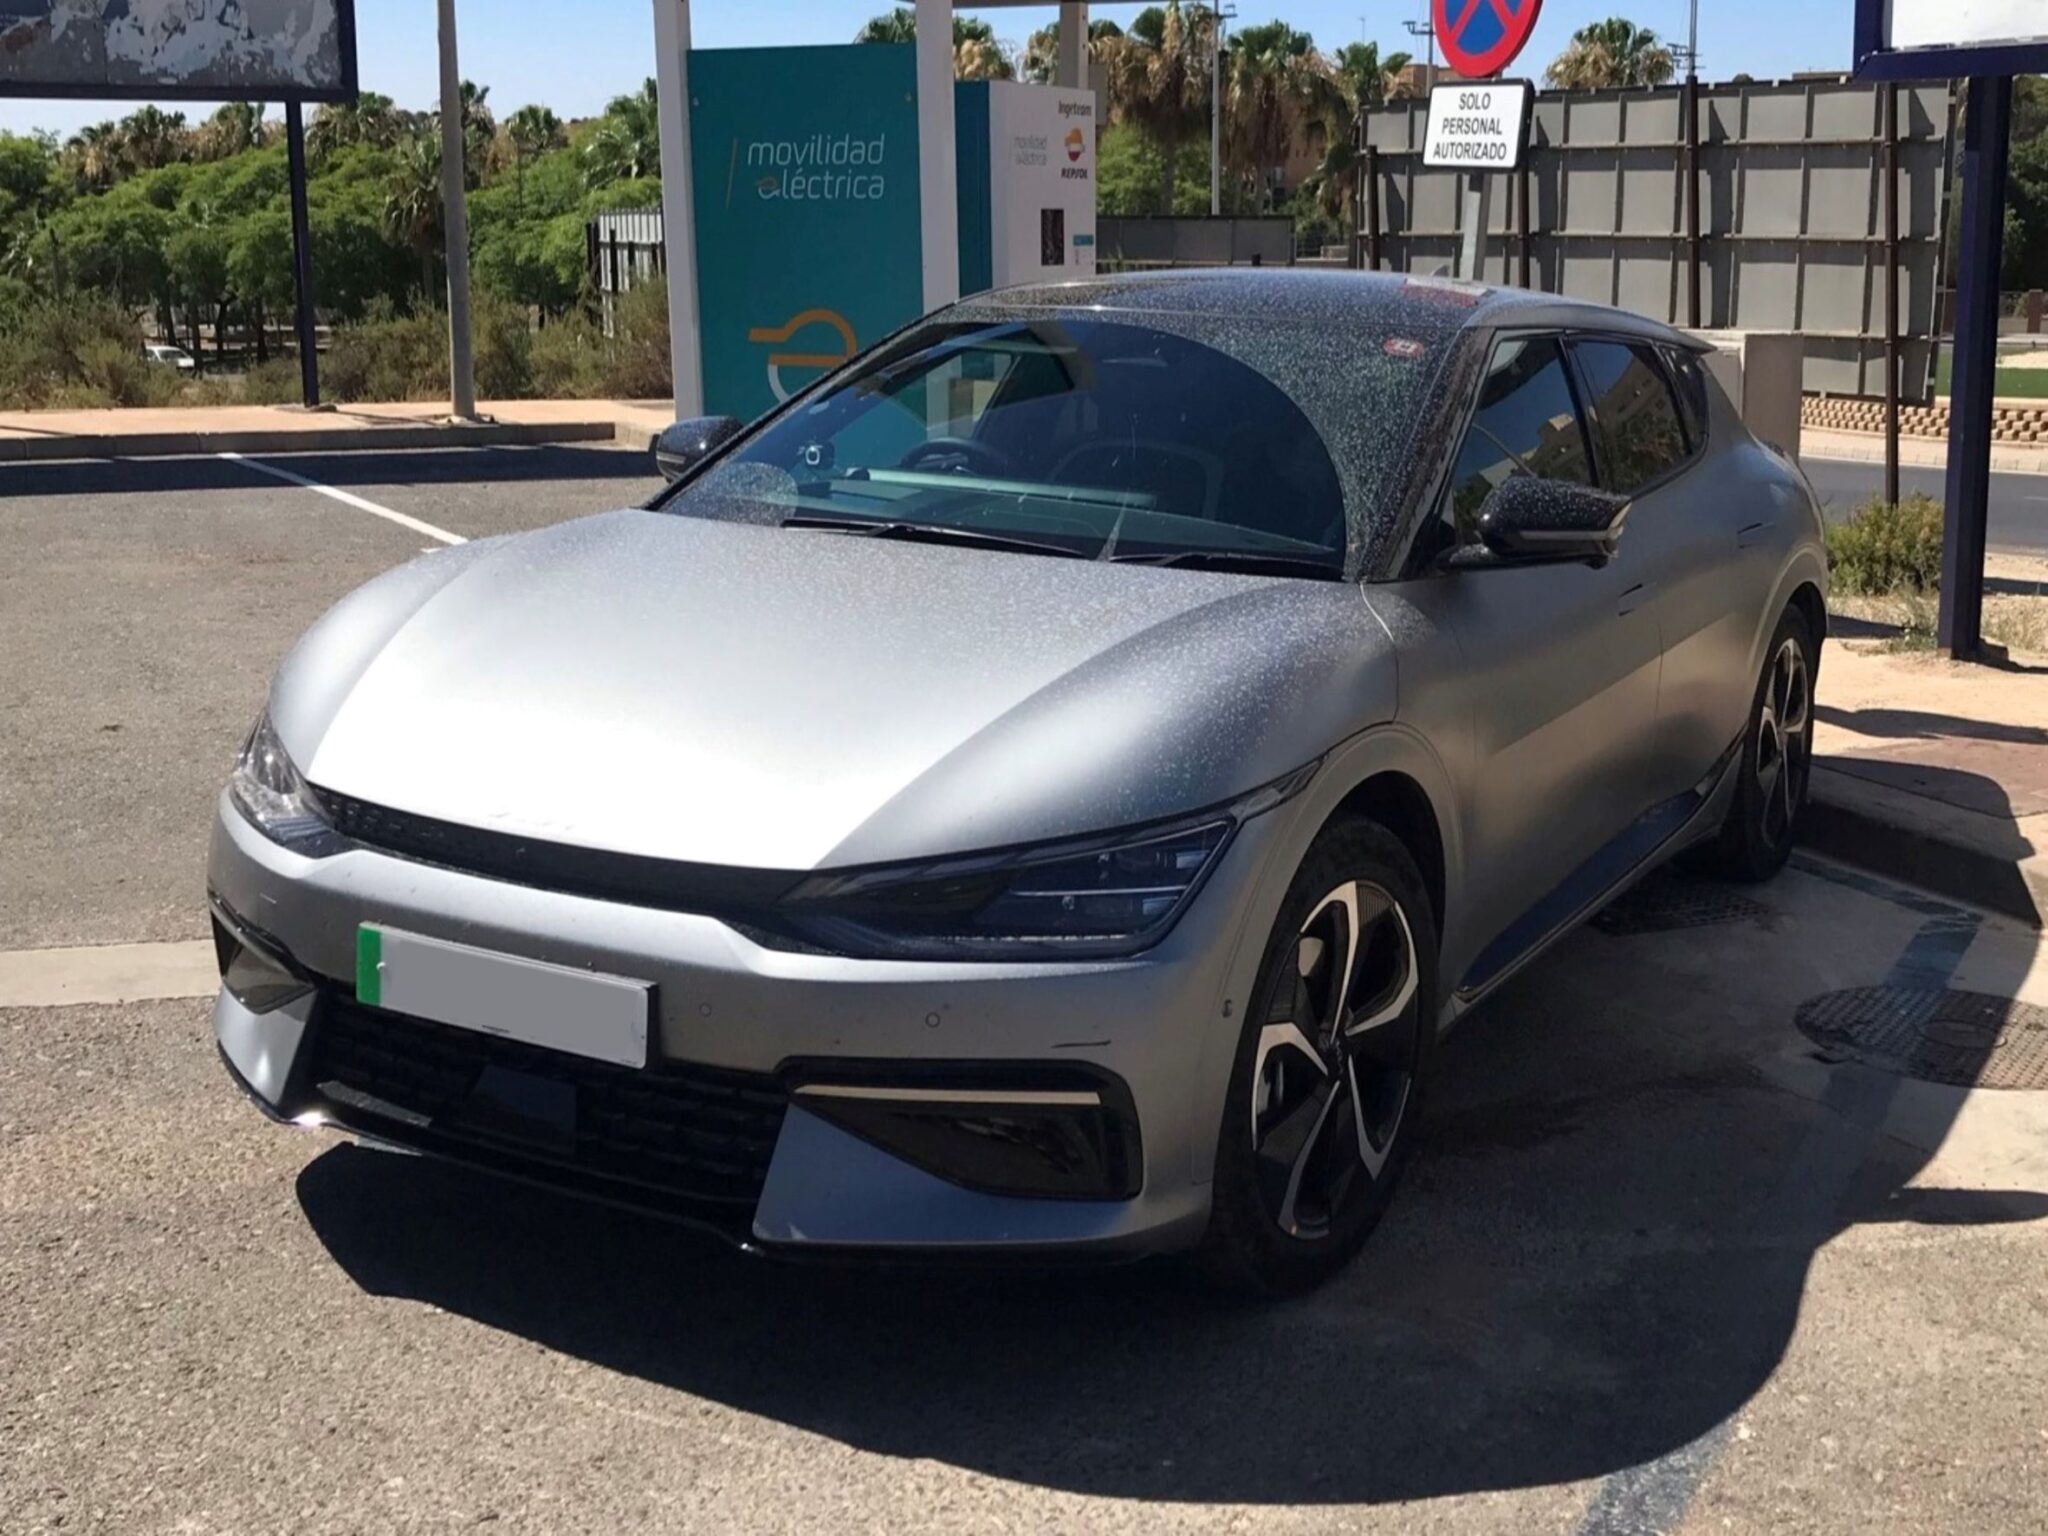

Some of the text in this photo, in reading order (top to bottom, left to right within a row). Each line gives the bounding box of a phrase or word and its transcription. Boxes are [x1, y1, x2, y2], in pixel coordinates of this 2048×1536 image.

[1458, 92, 1491, 110] SOLO
[1441, 117, 1503, 135] PERSONAL
[747, 132, 886, 166] movilidad
[1432, 142, 1507, 160] AUTORIZADO
[756, 167, 886, 199] eléctrica
